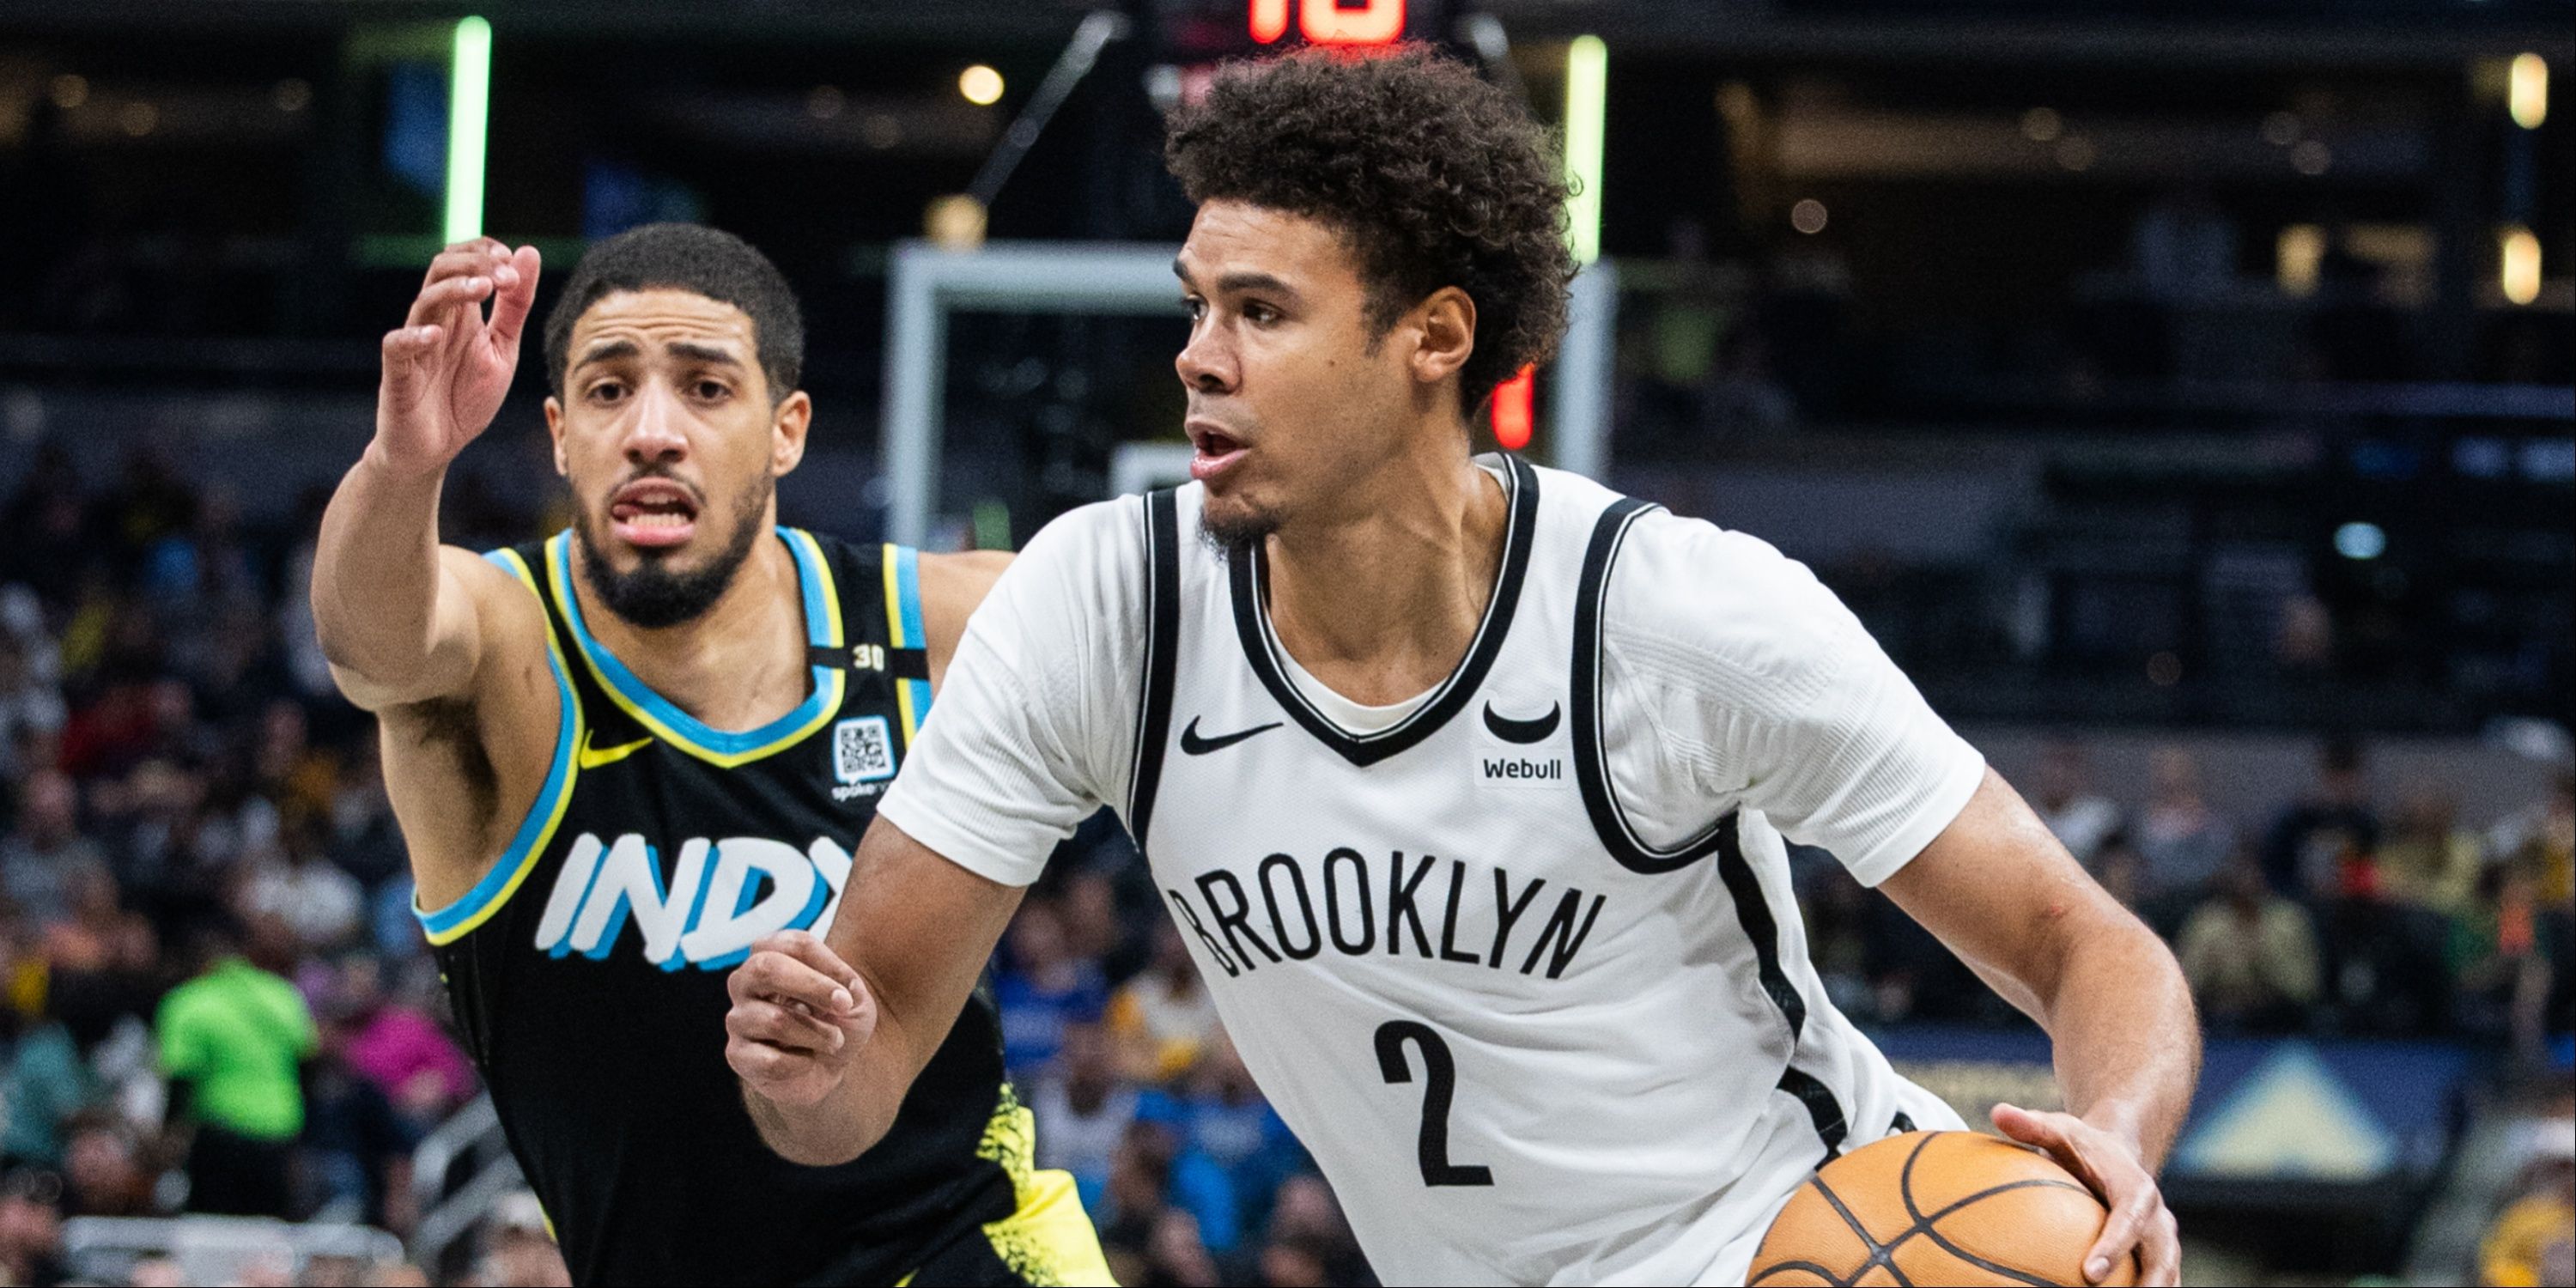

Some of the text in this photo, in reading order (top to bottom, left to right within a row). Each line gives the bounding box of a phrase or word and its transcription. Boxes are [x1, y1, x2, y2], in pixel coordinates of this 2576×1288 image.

[853, 644, 884, 671] 30
[1483, 758, 1561, 780] Webull
[1167, 848, 1607, 980] BROOKLYN
[1374, 1020, 1494, 1187] 2
